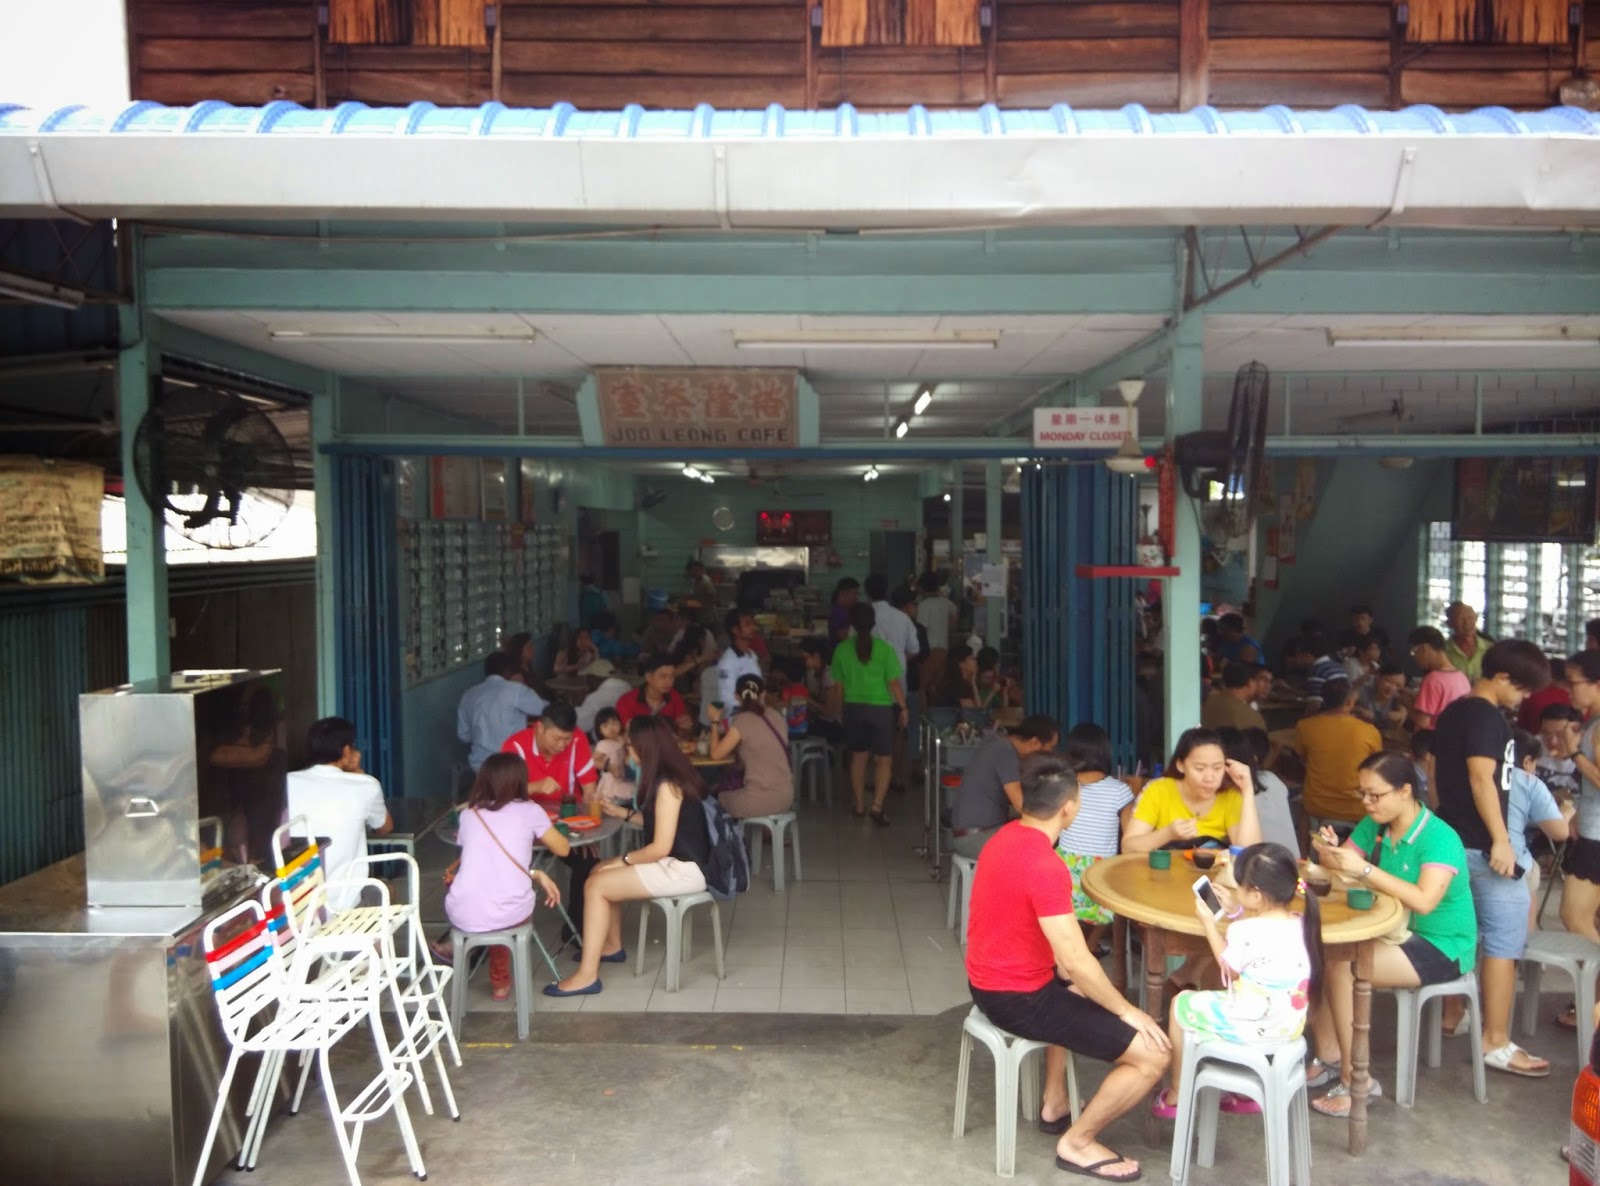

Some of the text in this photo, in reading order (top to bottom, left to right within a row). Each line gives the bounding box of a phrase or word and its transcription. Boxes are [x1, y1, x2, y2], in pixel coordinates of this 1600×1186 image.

[1051, 414, 1120, 425] 星期一休息
[612, 428, 789, 442] JOO LEONG CAFE
[1040, 431, 1085, 441] MONDAY
